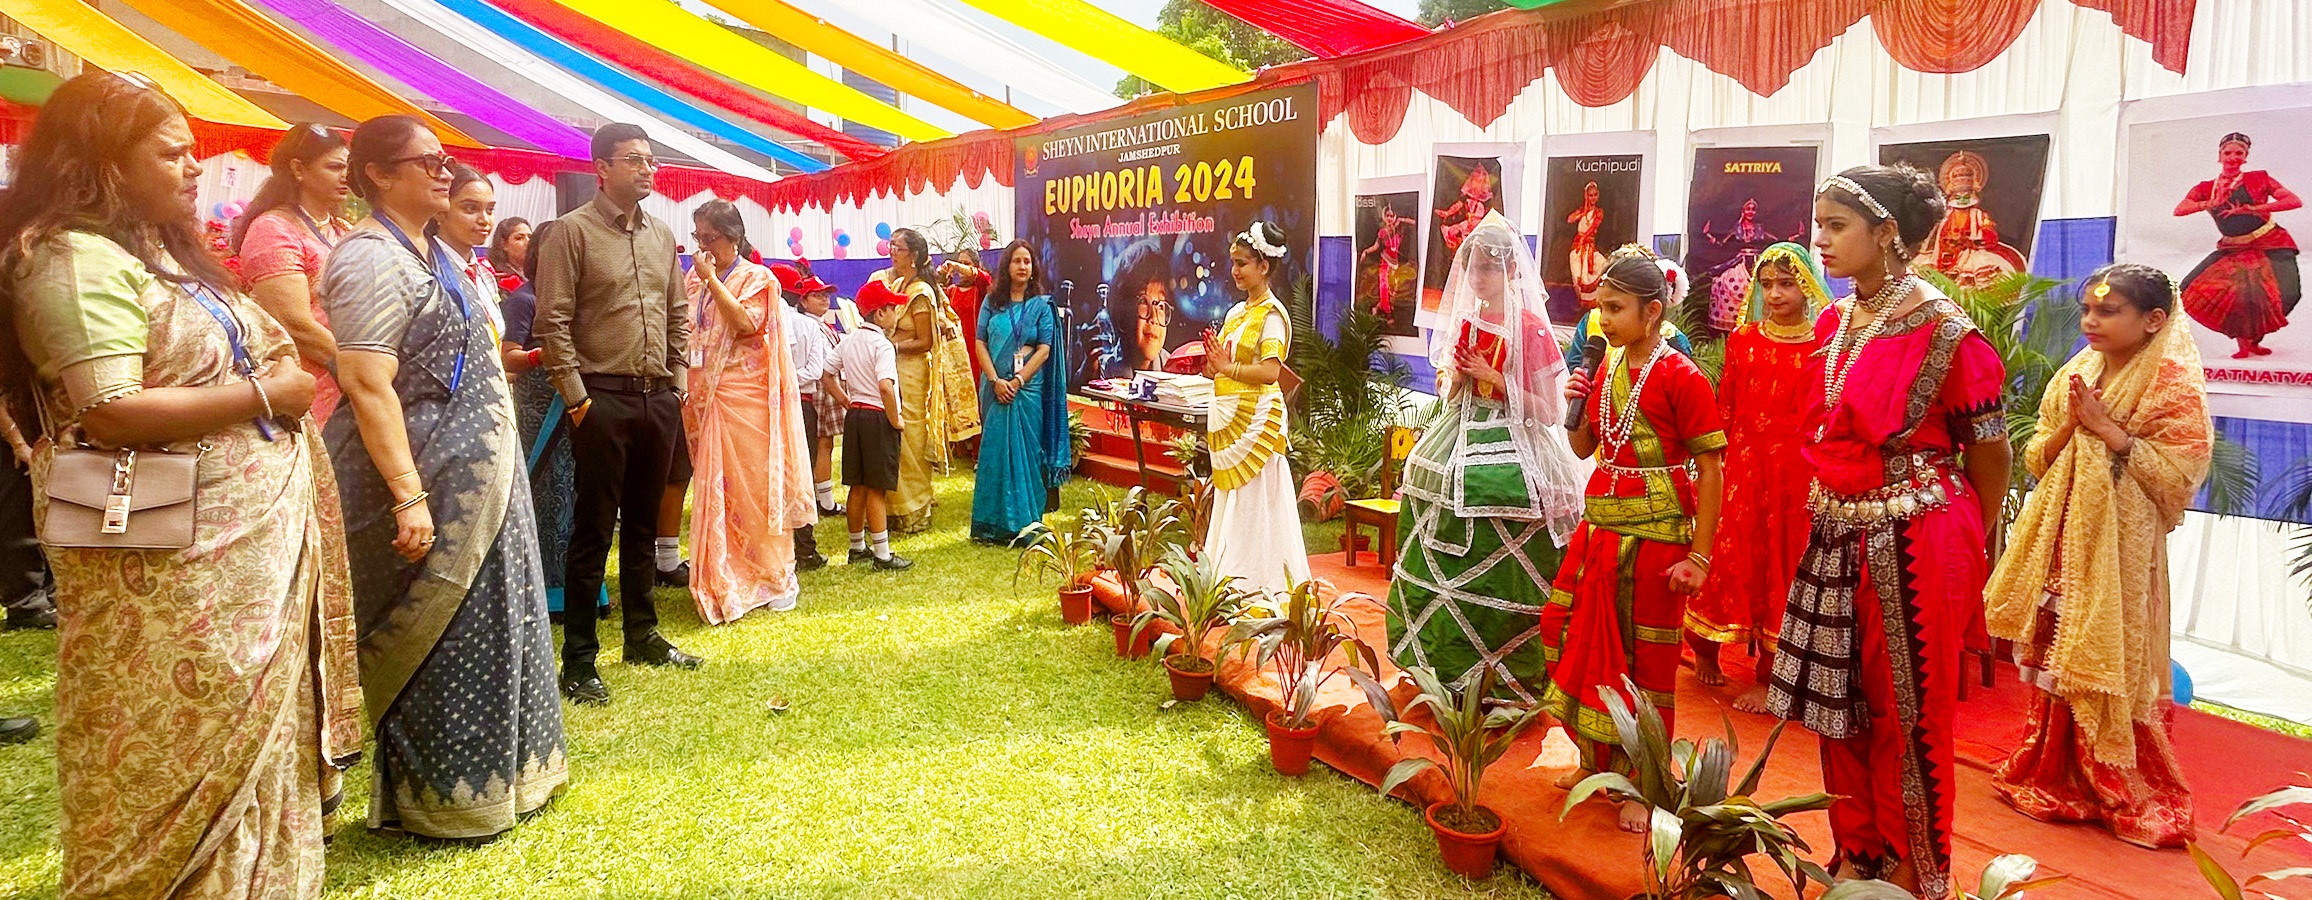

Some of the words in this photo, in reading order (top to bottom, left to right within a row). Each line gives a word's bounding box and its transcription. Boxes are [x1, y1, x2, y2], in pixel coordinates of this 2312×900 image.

[1042, 139, 1085, 161] SHEYN
[1085, 113, 1208, 152] INTERNATIONAL
[1213, 97, 1298, 132] SCHOOL
[1118, 144, 1181, 162] JAMSHEDPUR
[1575, 158, 1641, 174] Kuchipudi
[1724, 161, 1782, 174] SATTRIYA
[1045, 165, 1164, 215] EUPHORIA
[1174, 155, 1256, 203] 2024
[1069, 215, 1101, 244] Sheyn
[1102, 212, 1145, 237] Annual
[1147, 209, 1215, 236] Exhibition
